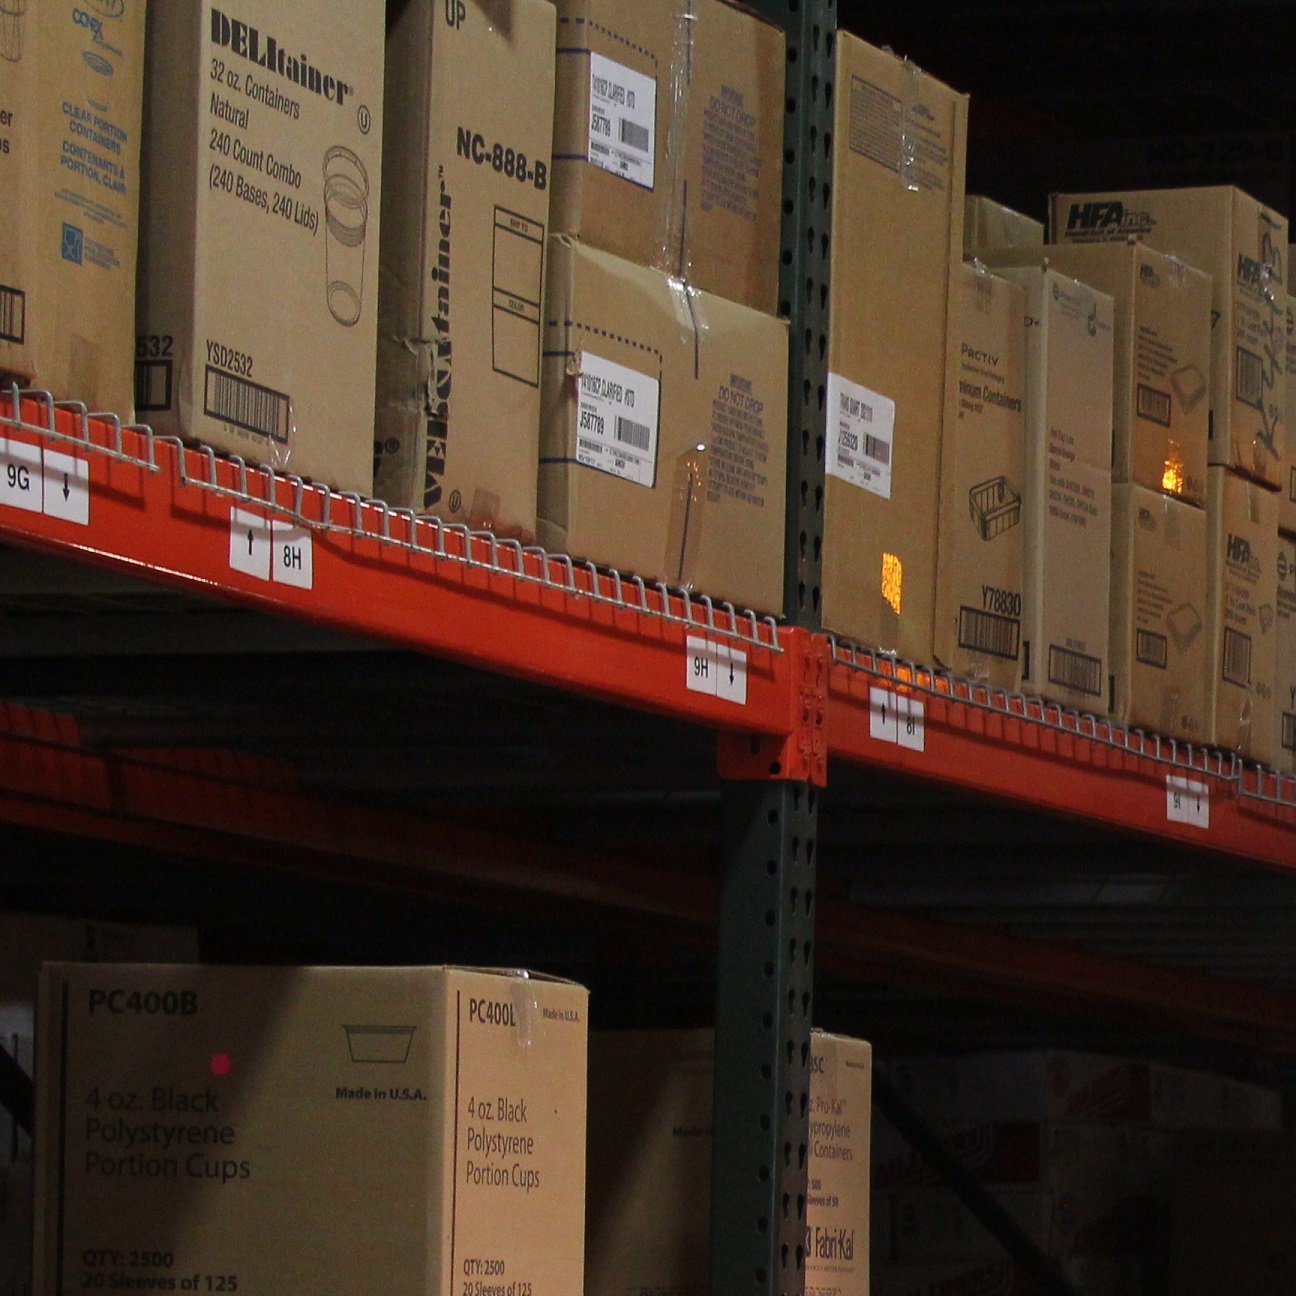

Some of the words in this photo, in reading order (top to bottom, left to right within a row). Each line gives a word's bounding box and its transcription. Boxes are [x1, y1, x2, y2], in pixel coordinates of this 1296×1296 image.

[209, 57, 224, 84] 32
[226, 71, 241, 92] oz.
[244, 74, 300, 120] Containers
[209, 91, 249, 130] Natural
[209, 128, 230, 156] 240
[232, 139, 264, 172] Count
[265, 153, 302, 189] Combo
[456, 125, 547, 191] NC-888-B
[208, 162, 234, 194] (240
[235, 174, 270, 215] Bases,
[271, 192, 292, 223] 240
[293, 202, 319, 237] Lids)
[205, 339, 254, 378] YSD2532
[961, 342, 999, 367] PACTIV
[7, 463, 30, 491] 9G
[283, 544, 302, 570] 8H
[981, 584, 1022, 618] Y78830
[693, 655, 709, 679] 9H
[87, 988, 199, 1016] PC400B
[151, 1086, 218, 1114] Black
[335, 1086, 372, 1101] Made
[373, 1086, 387, 1101] in
[389, 1087, 427, 1101] U.S.A.
[467, 1096, 475, 1119] 4
[478, 1101, 495, 1121] oz.
[497, 1097, 527, 1123] Black
[85, 1115, 235, 1150] Polystyrene
[467, 1126, 534, 1160] Polystyrene
[84, 1150, 179, 1180] Portion
[185, 1151, 251, 1185] Cups
[466, 1160, 509, 1187] Portion
[511, 1163, 540, 1195] Cups
[82, 1250, 126, 1269] QTY:
[129, 1250, 175, 1269] 2500
[463, 1258, 484, 1276] QTY:
[484, 1258, 505, 1276] 2500
[82, 1273, 105, 1290] 20
[109, 1272, 176, 1291] Sleeves
[180, 1273, 200, 1291] of
[205, 1274, 239, 1293] 125
